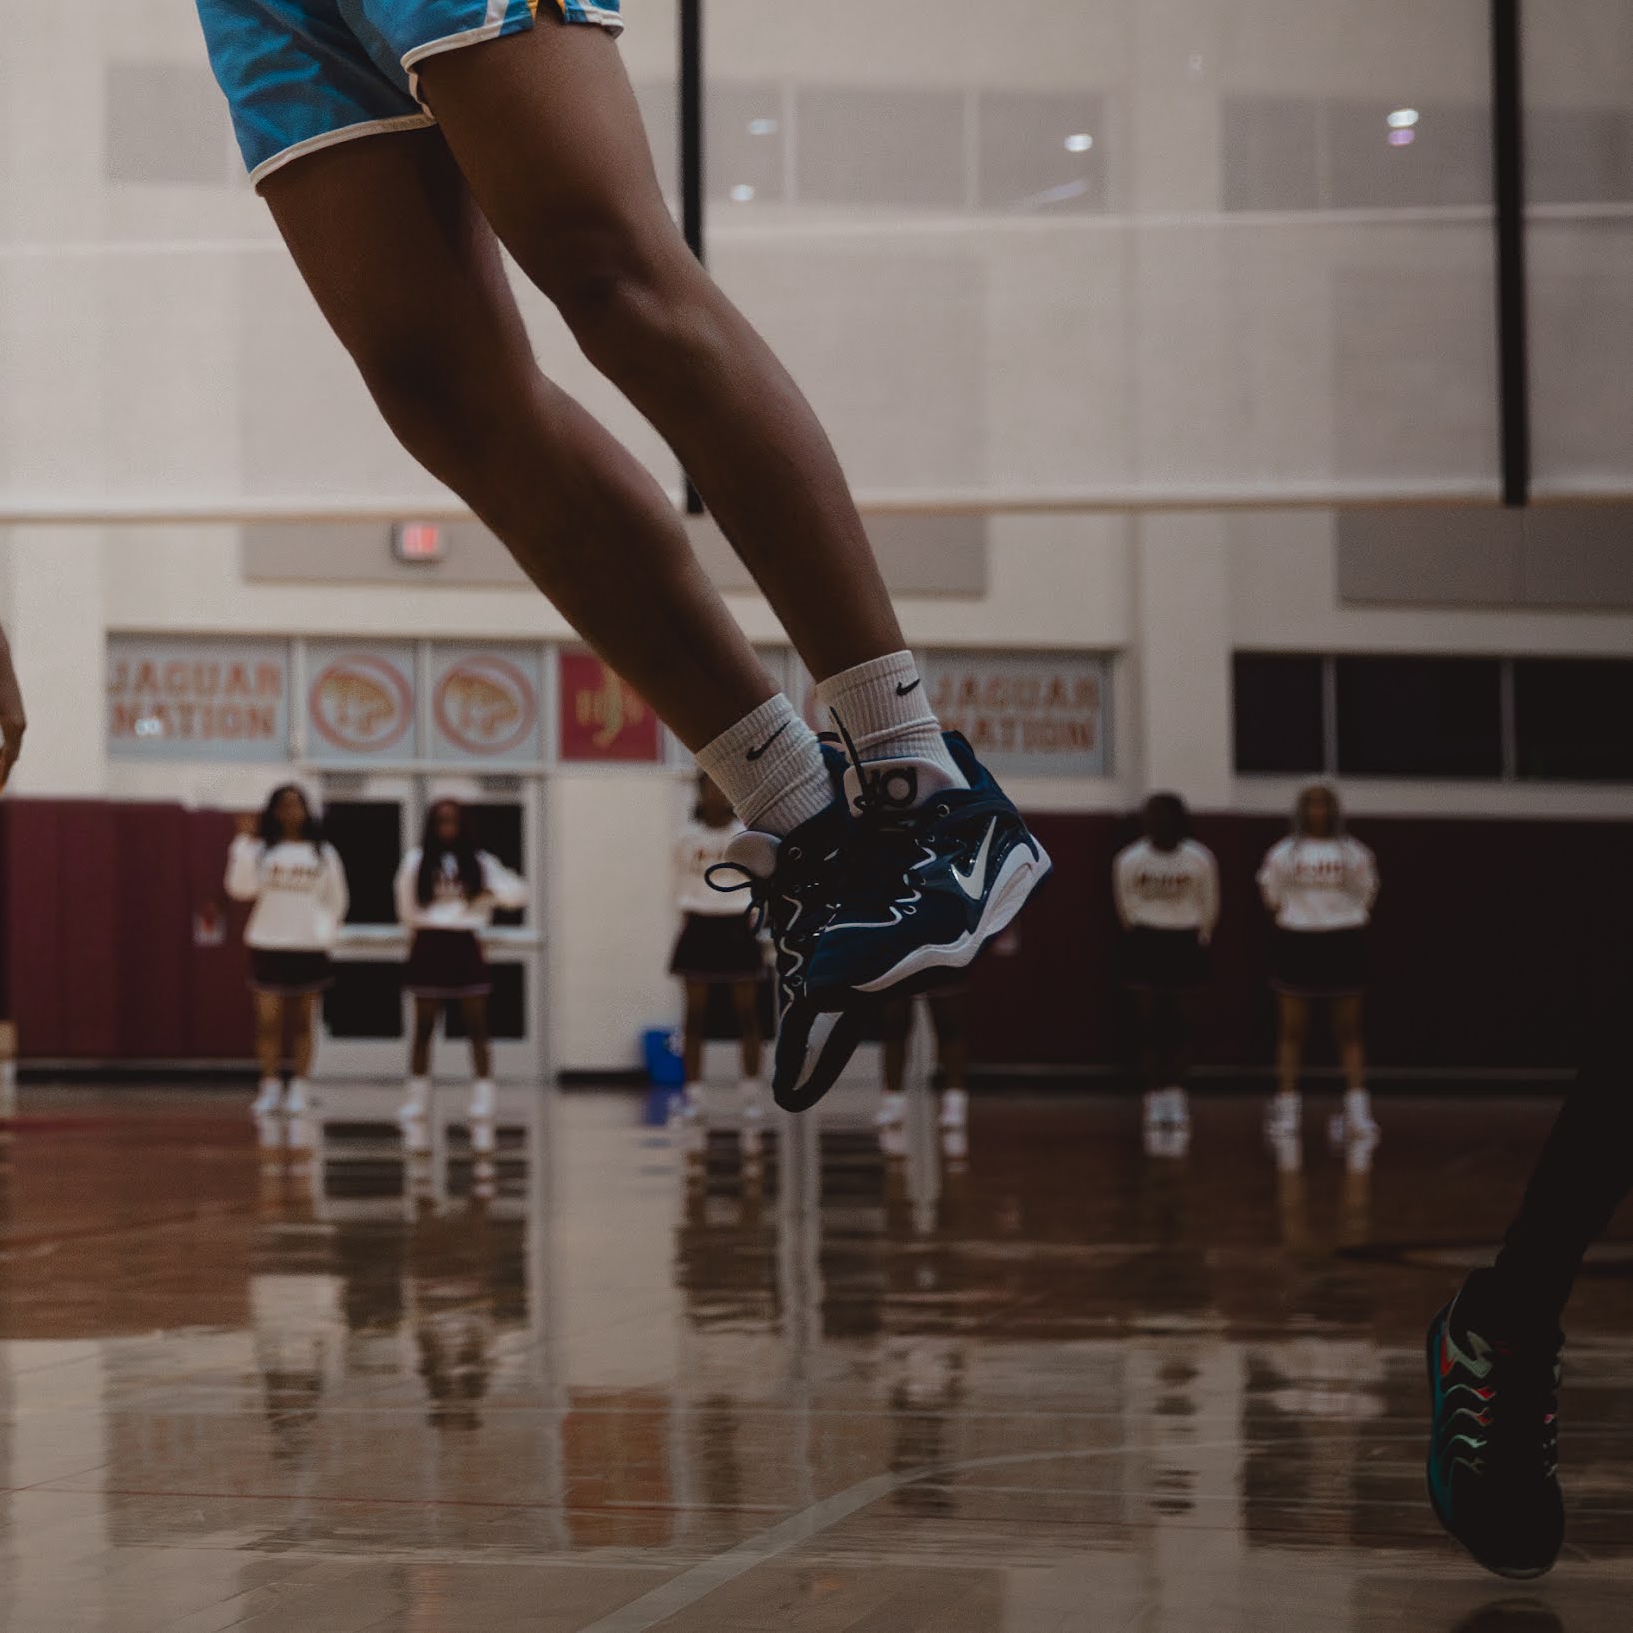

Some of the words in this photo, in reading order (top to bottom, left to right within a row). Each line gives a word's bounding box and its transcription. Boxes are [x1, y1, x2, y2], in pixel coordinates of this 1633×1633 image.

[108, 656, 282, 701] JAGUAR
[934, 673, 1100, 710] JAGUAR
[109, 700, 277, 743] NATION
